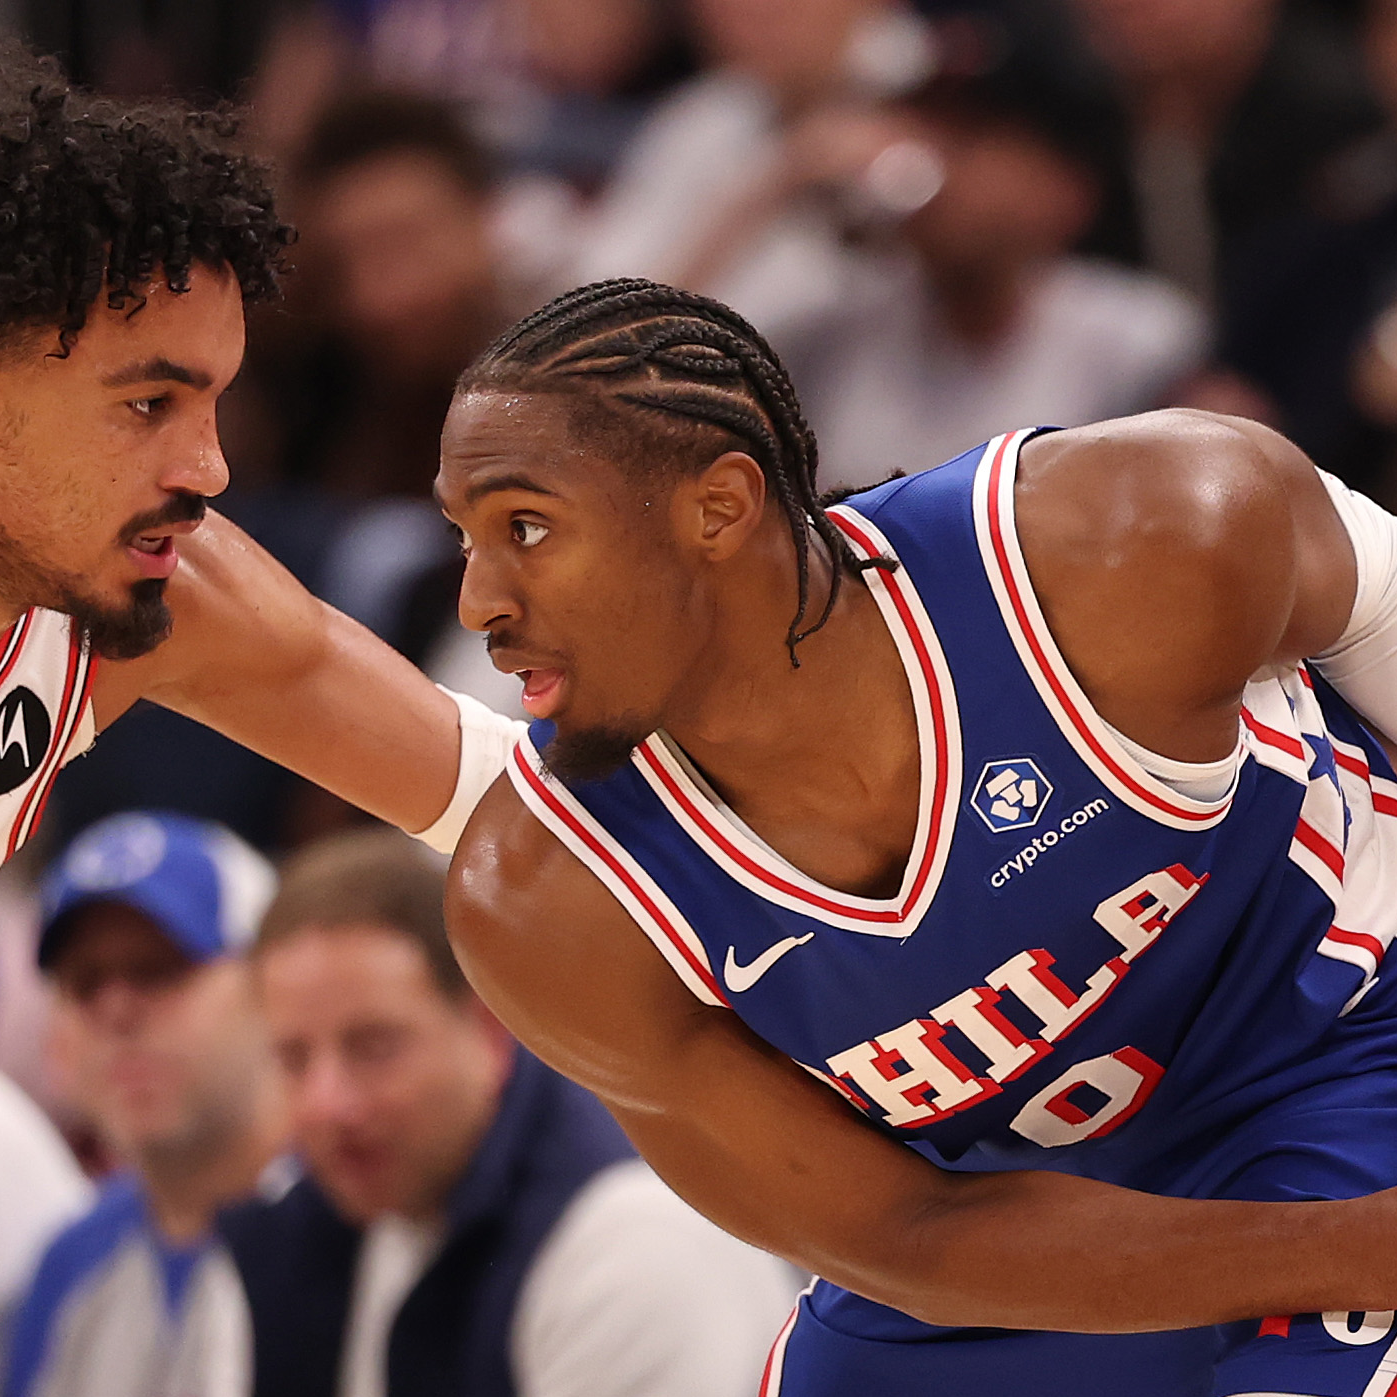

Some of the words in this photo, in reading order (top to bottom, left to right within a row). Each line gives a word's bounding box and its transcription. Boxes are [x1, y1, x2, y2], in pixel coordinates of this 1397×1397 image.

[990, 797, 1111, 888] crypto.com
[791, 862, 1210, 1130] HILA
[1009, 1046, 1166, 1149] 0
